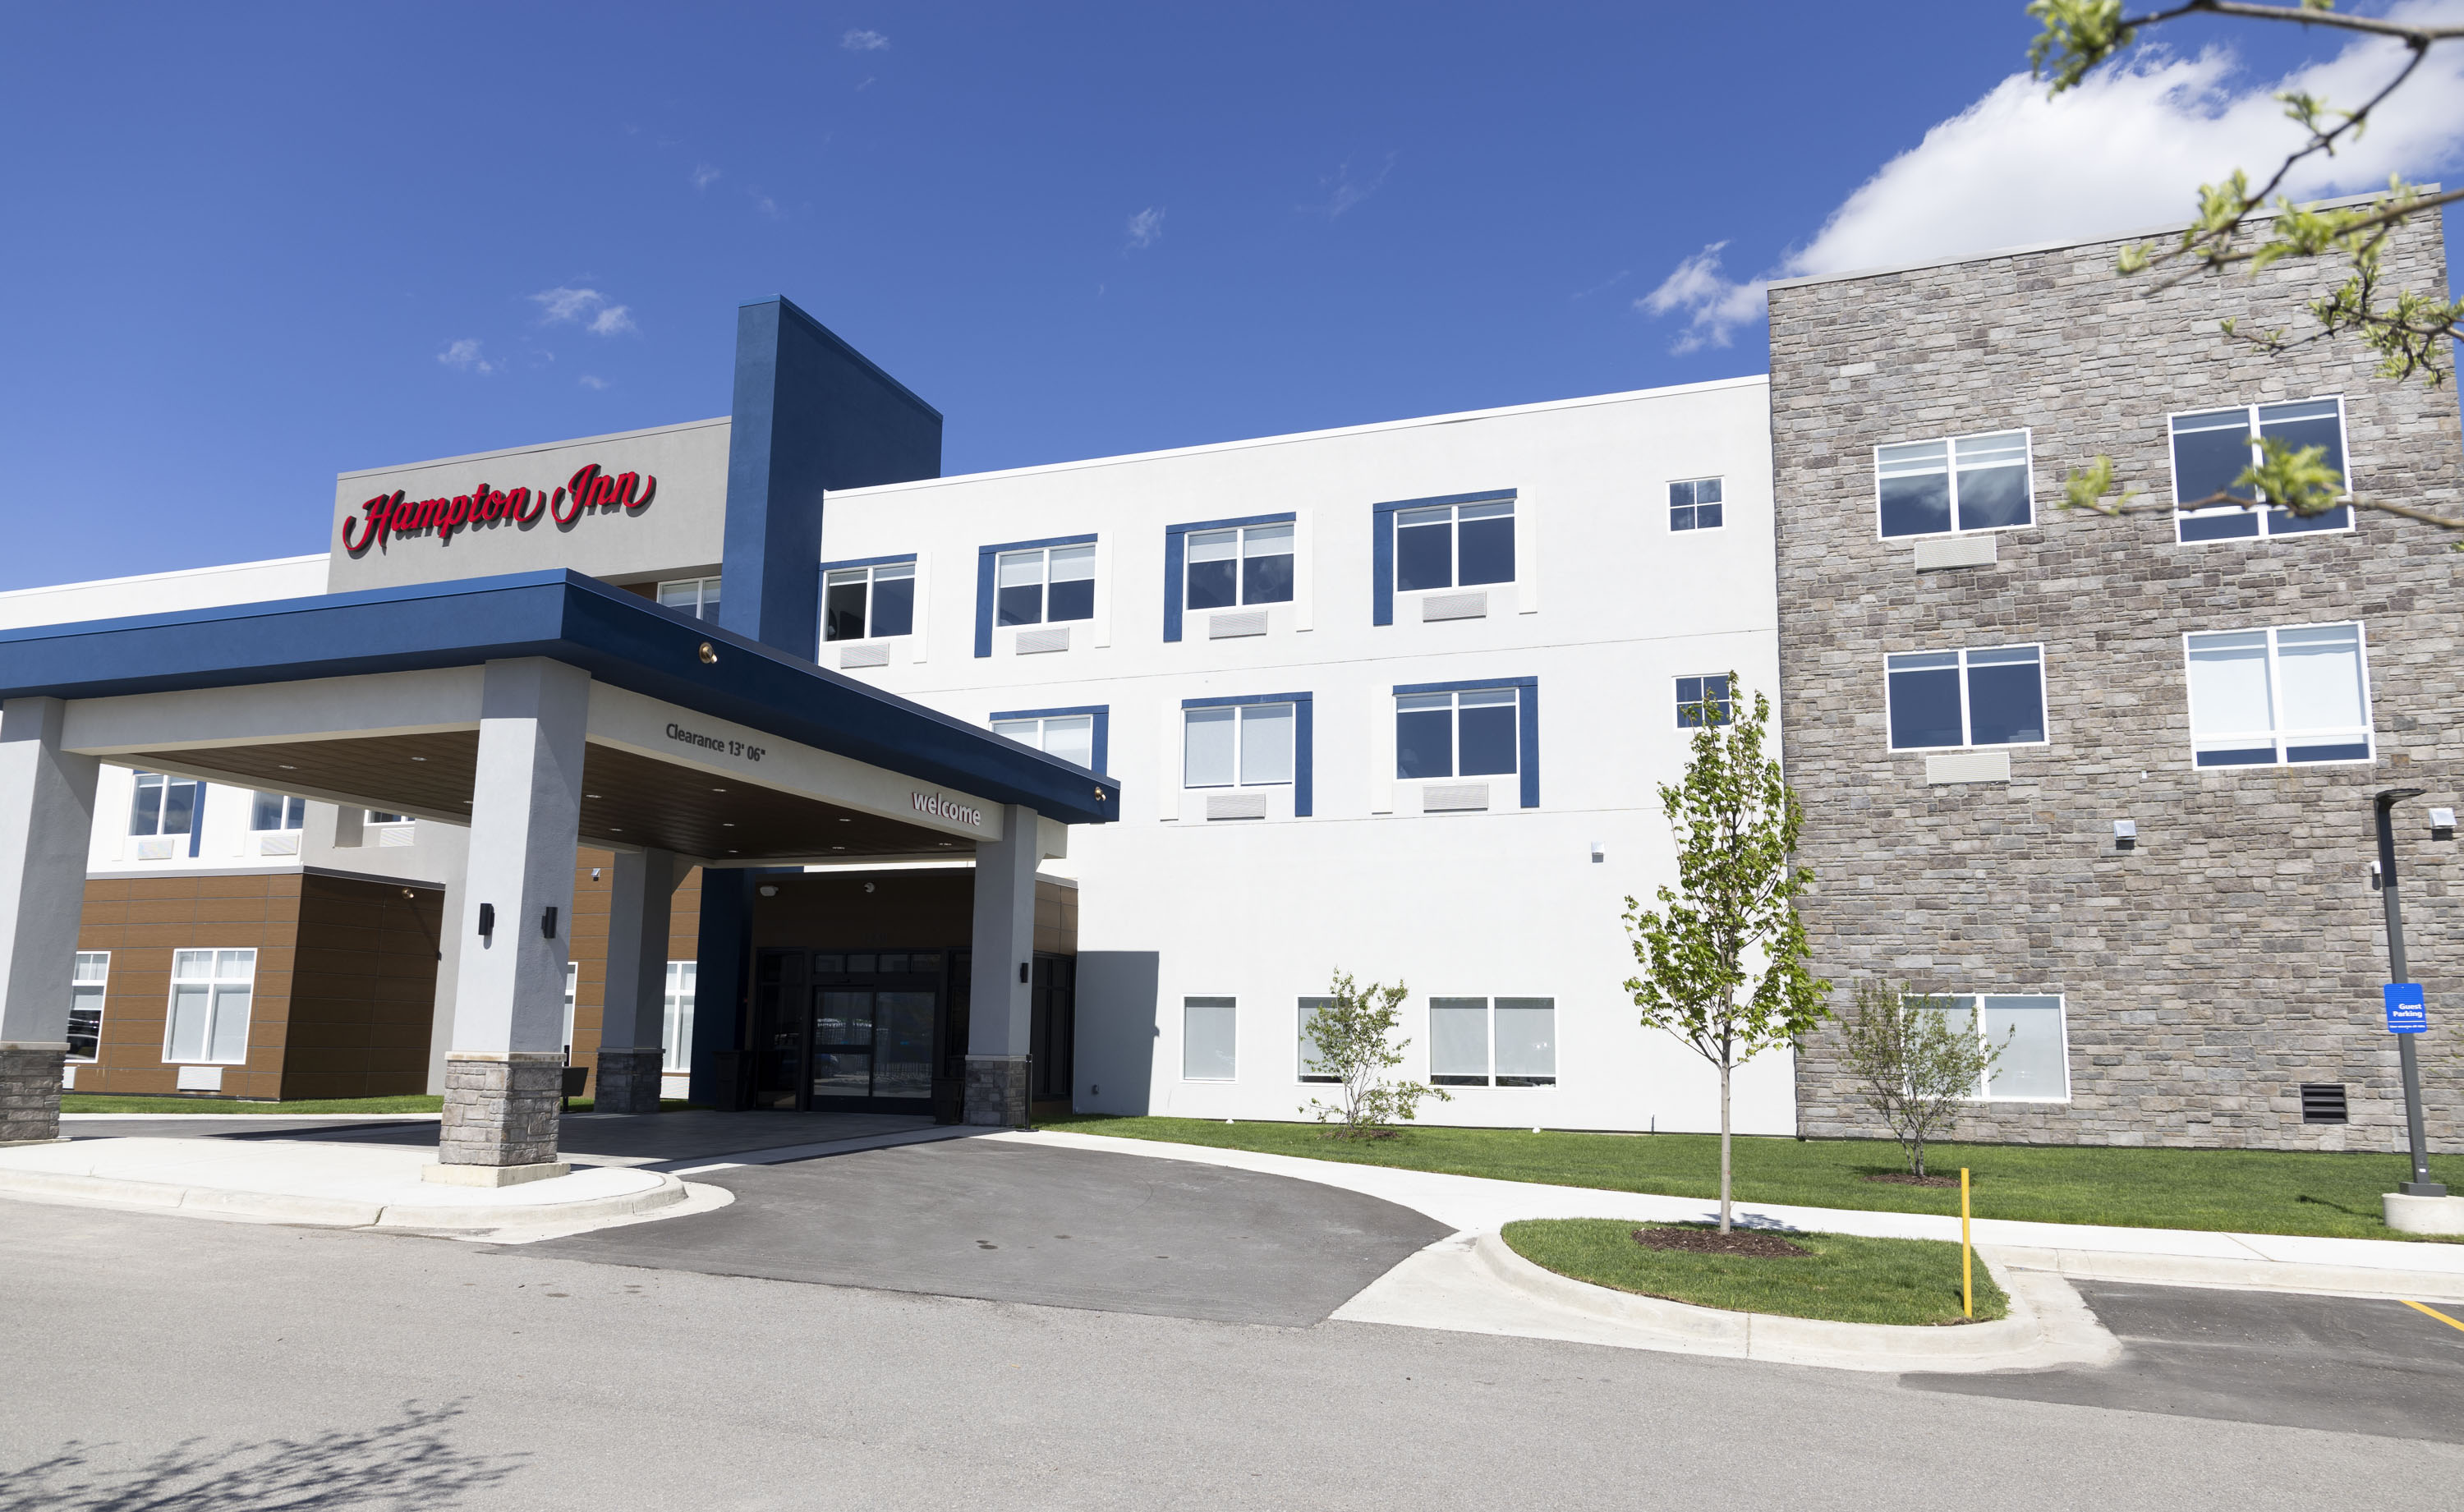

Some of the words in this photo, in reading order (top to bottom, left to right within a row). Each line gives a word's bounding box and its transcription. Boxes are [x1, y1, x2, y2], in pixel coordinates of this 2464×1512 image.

[342, 483, 545, 551] Hampton
[551, 463, 656, 524] Inn
[666, 723, 724, 752] Clearance
[729, 741, 744, 757] 13'
[747, 746, 766, 761] 06"
[912, 792, 981, 826] welcome
